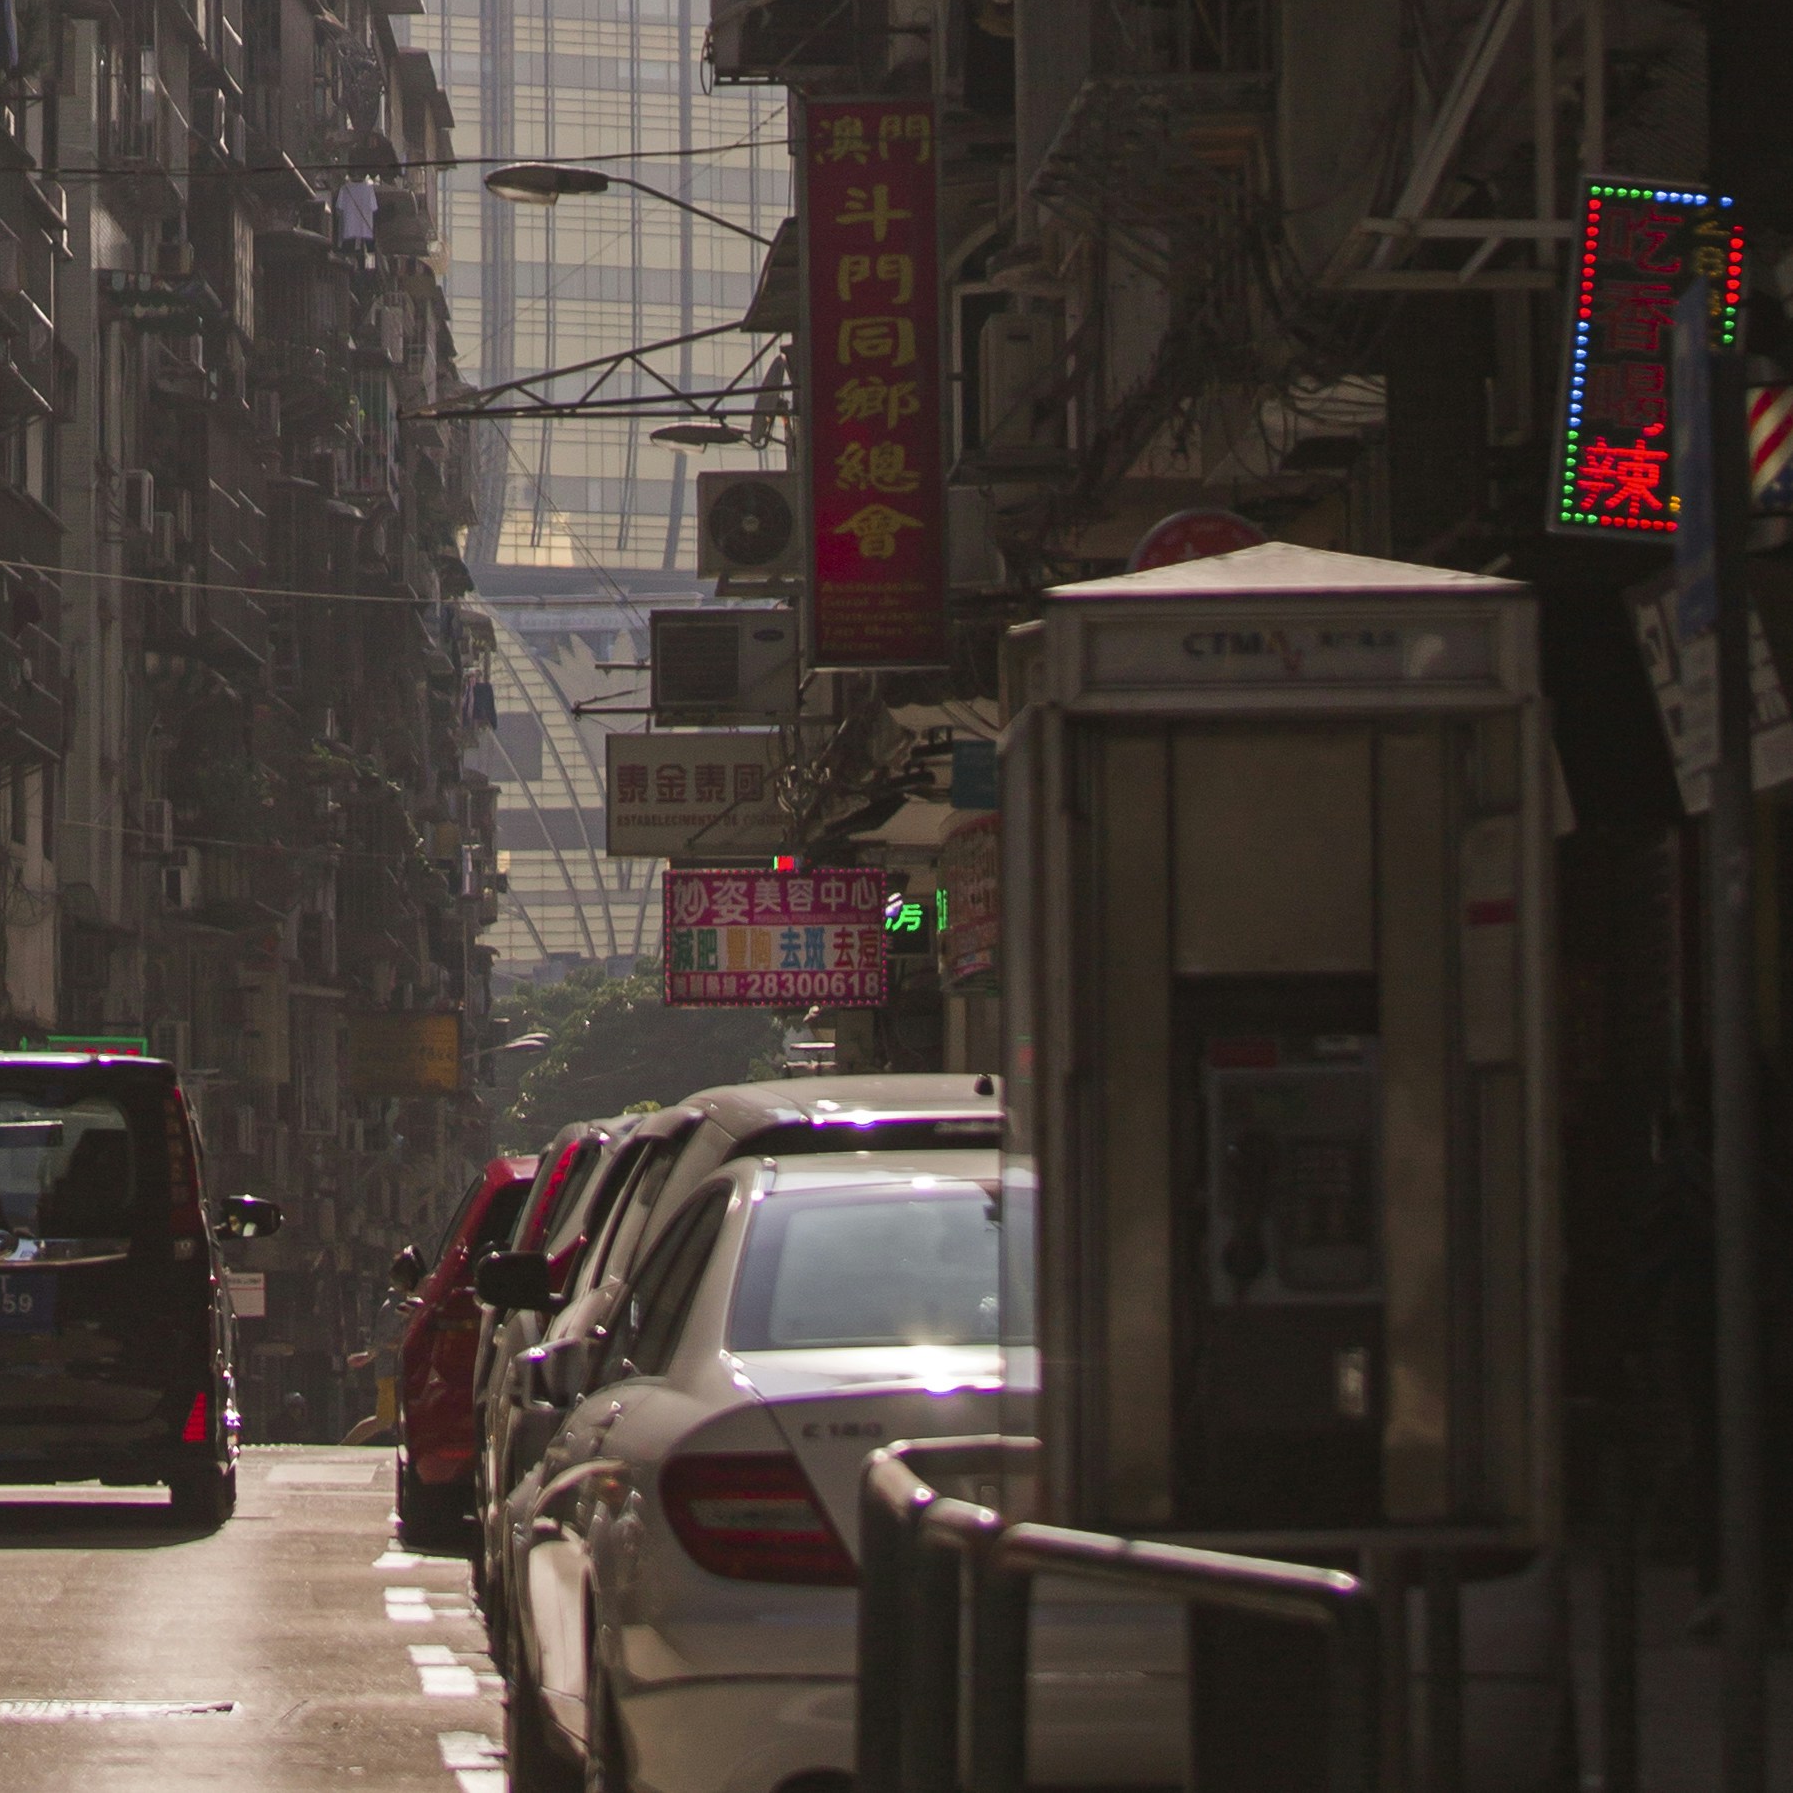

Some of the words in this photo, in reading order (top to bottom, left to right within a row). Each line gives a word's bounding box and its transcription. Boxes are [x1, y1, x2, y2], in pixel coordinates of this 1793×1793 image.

[815, 116, 931, 166] 澳門
[834, 184, 923, 560] 斗門同鄉總會
[1578, 204, 1684, 516] 吃香喝辣
[673, 877, 879, 924] 妙姿美容中心
[780, 928, 825, 969] 去斑
[833, 927, 880, 969] 去痘
